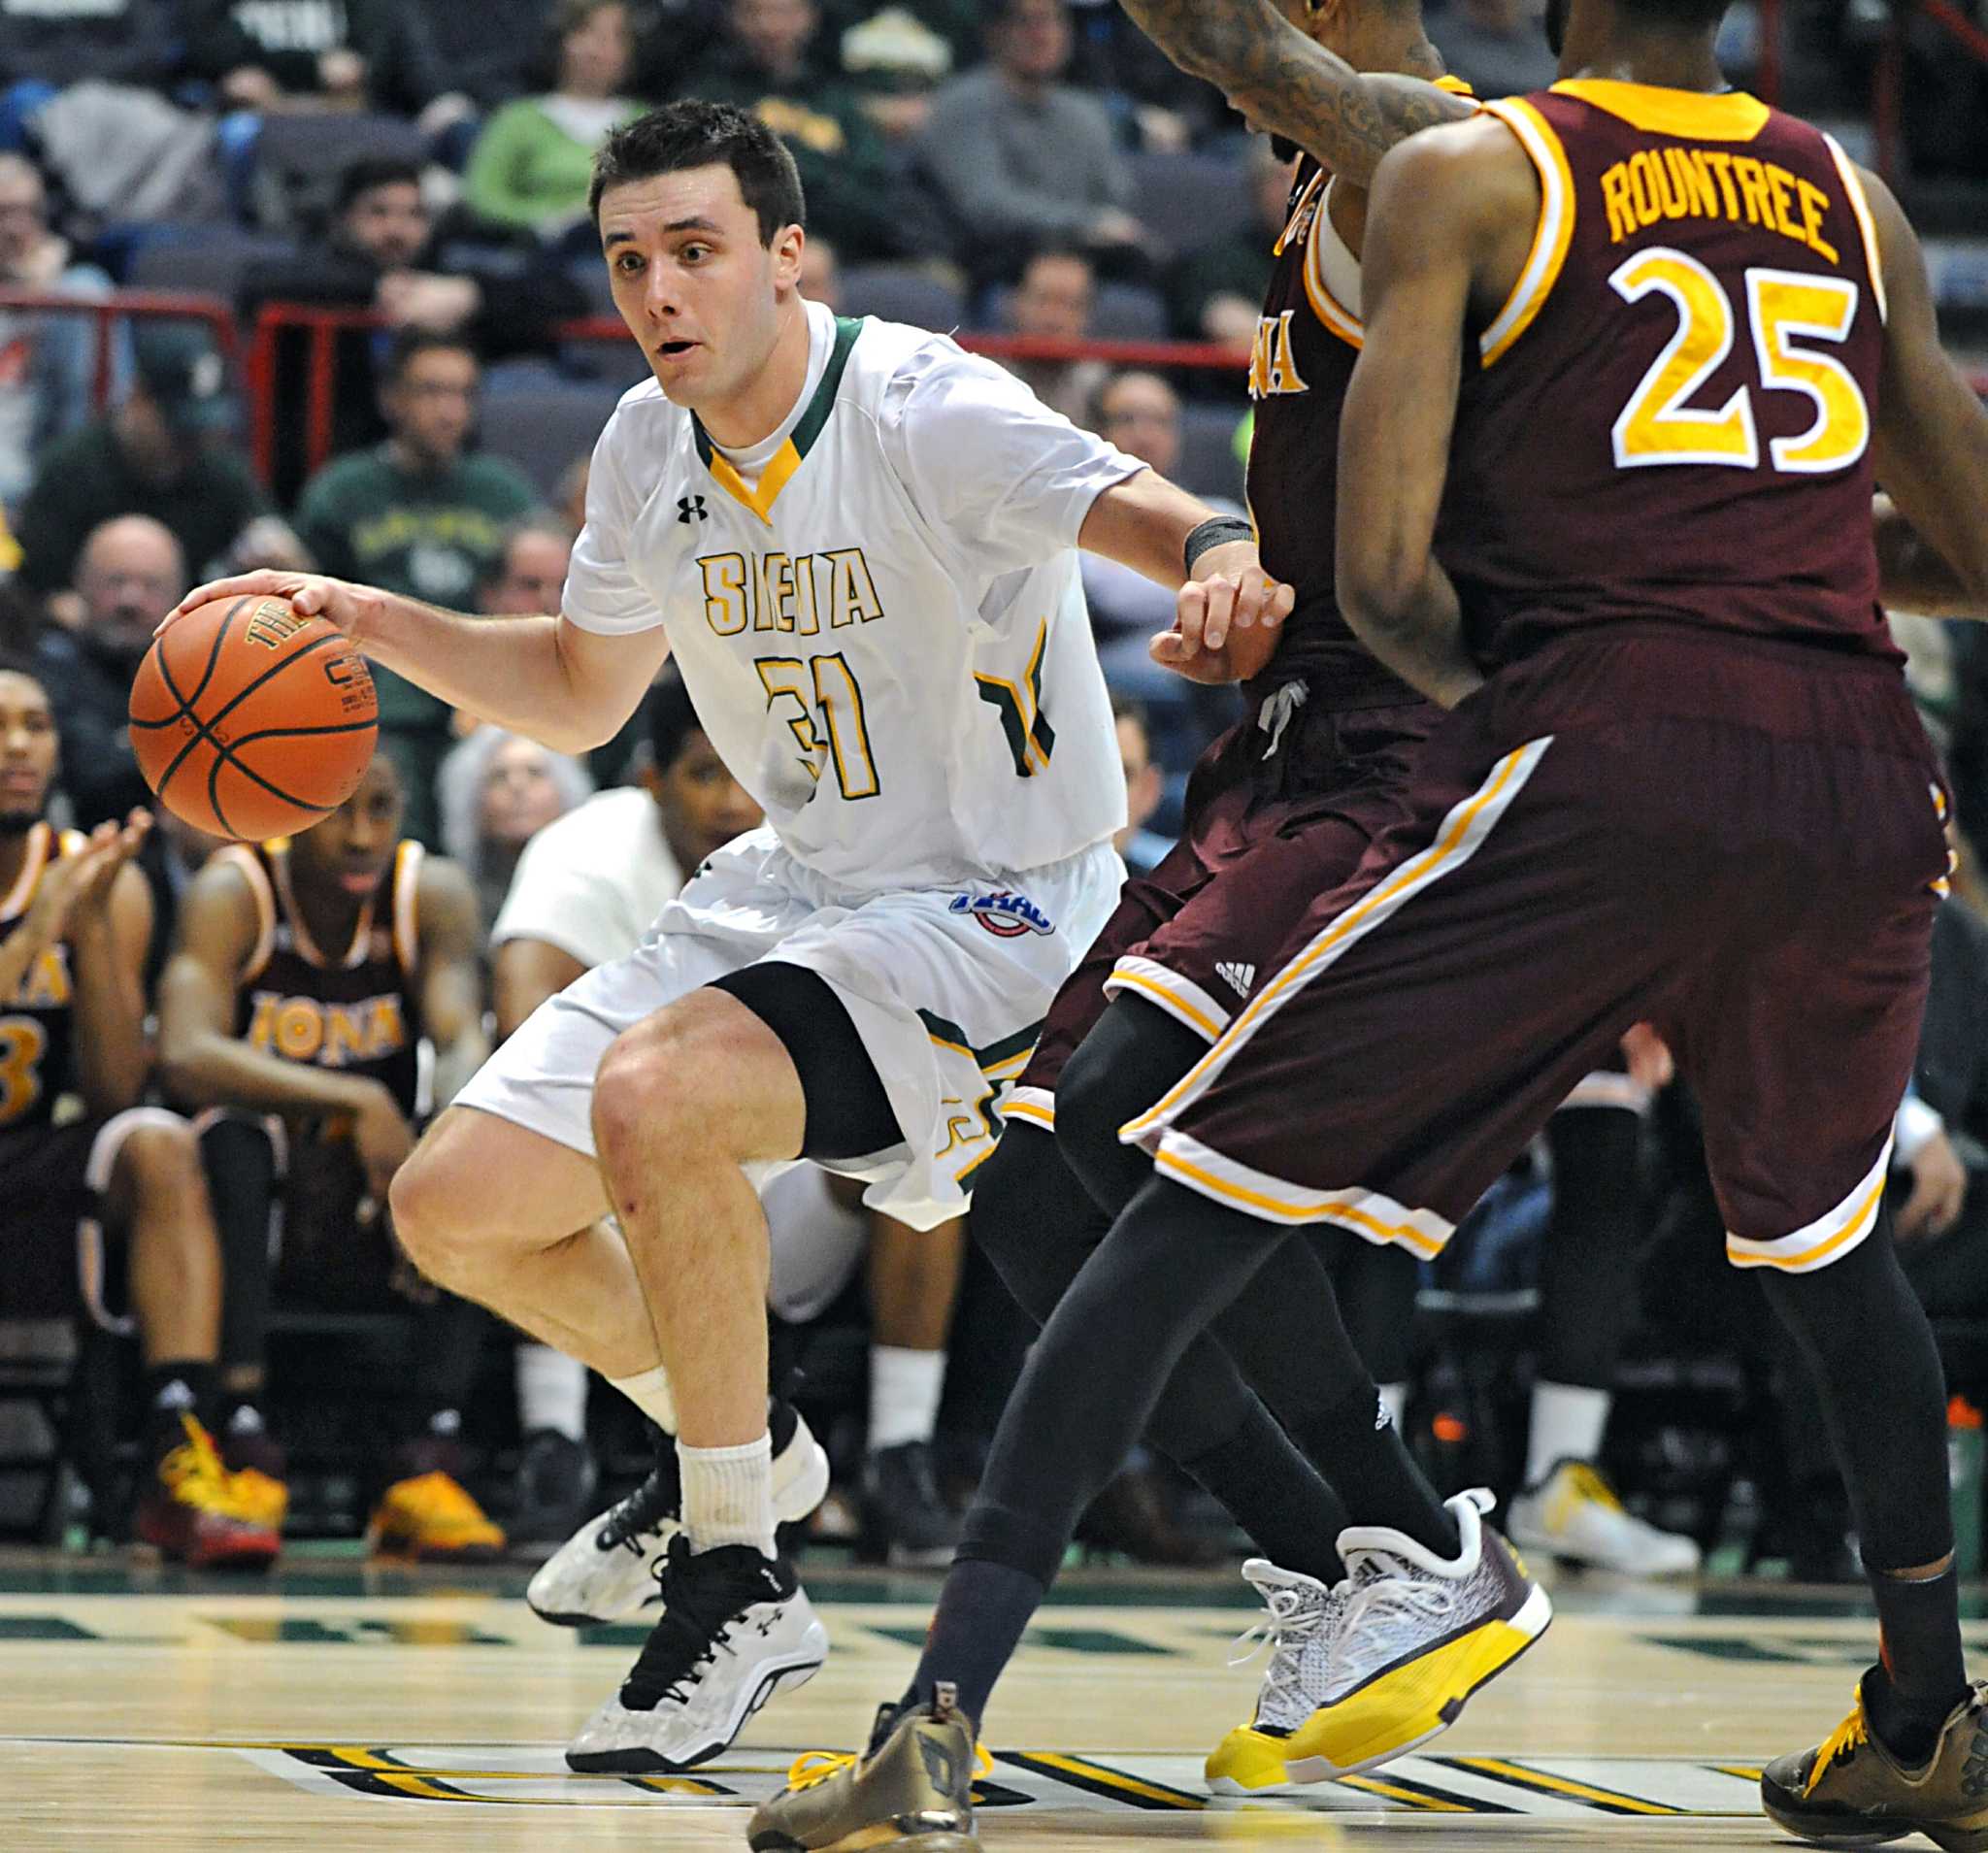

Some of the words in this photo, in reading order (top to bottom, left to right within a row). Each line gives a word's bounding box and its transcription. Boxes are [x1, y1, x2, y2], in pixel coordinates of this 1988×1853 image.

[1601, 148, 1839, 266] ROUNTREE
[1248, 310, 1309, 400] NA
[1607, 246, 1871, 474] 25
[245, 601, 311, 650] THE
[248, 989, 404, 1067] IONA
